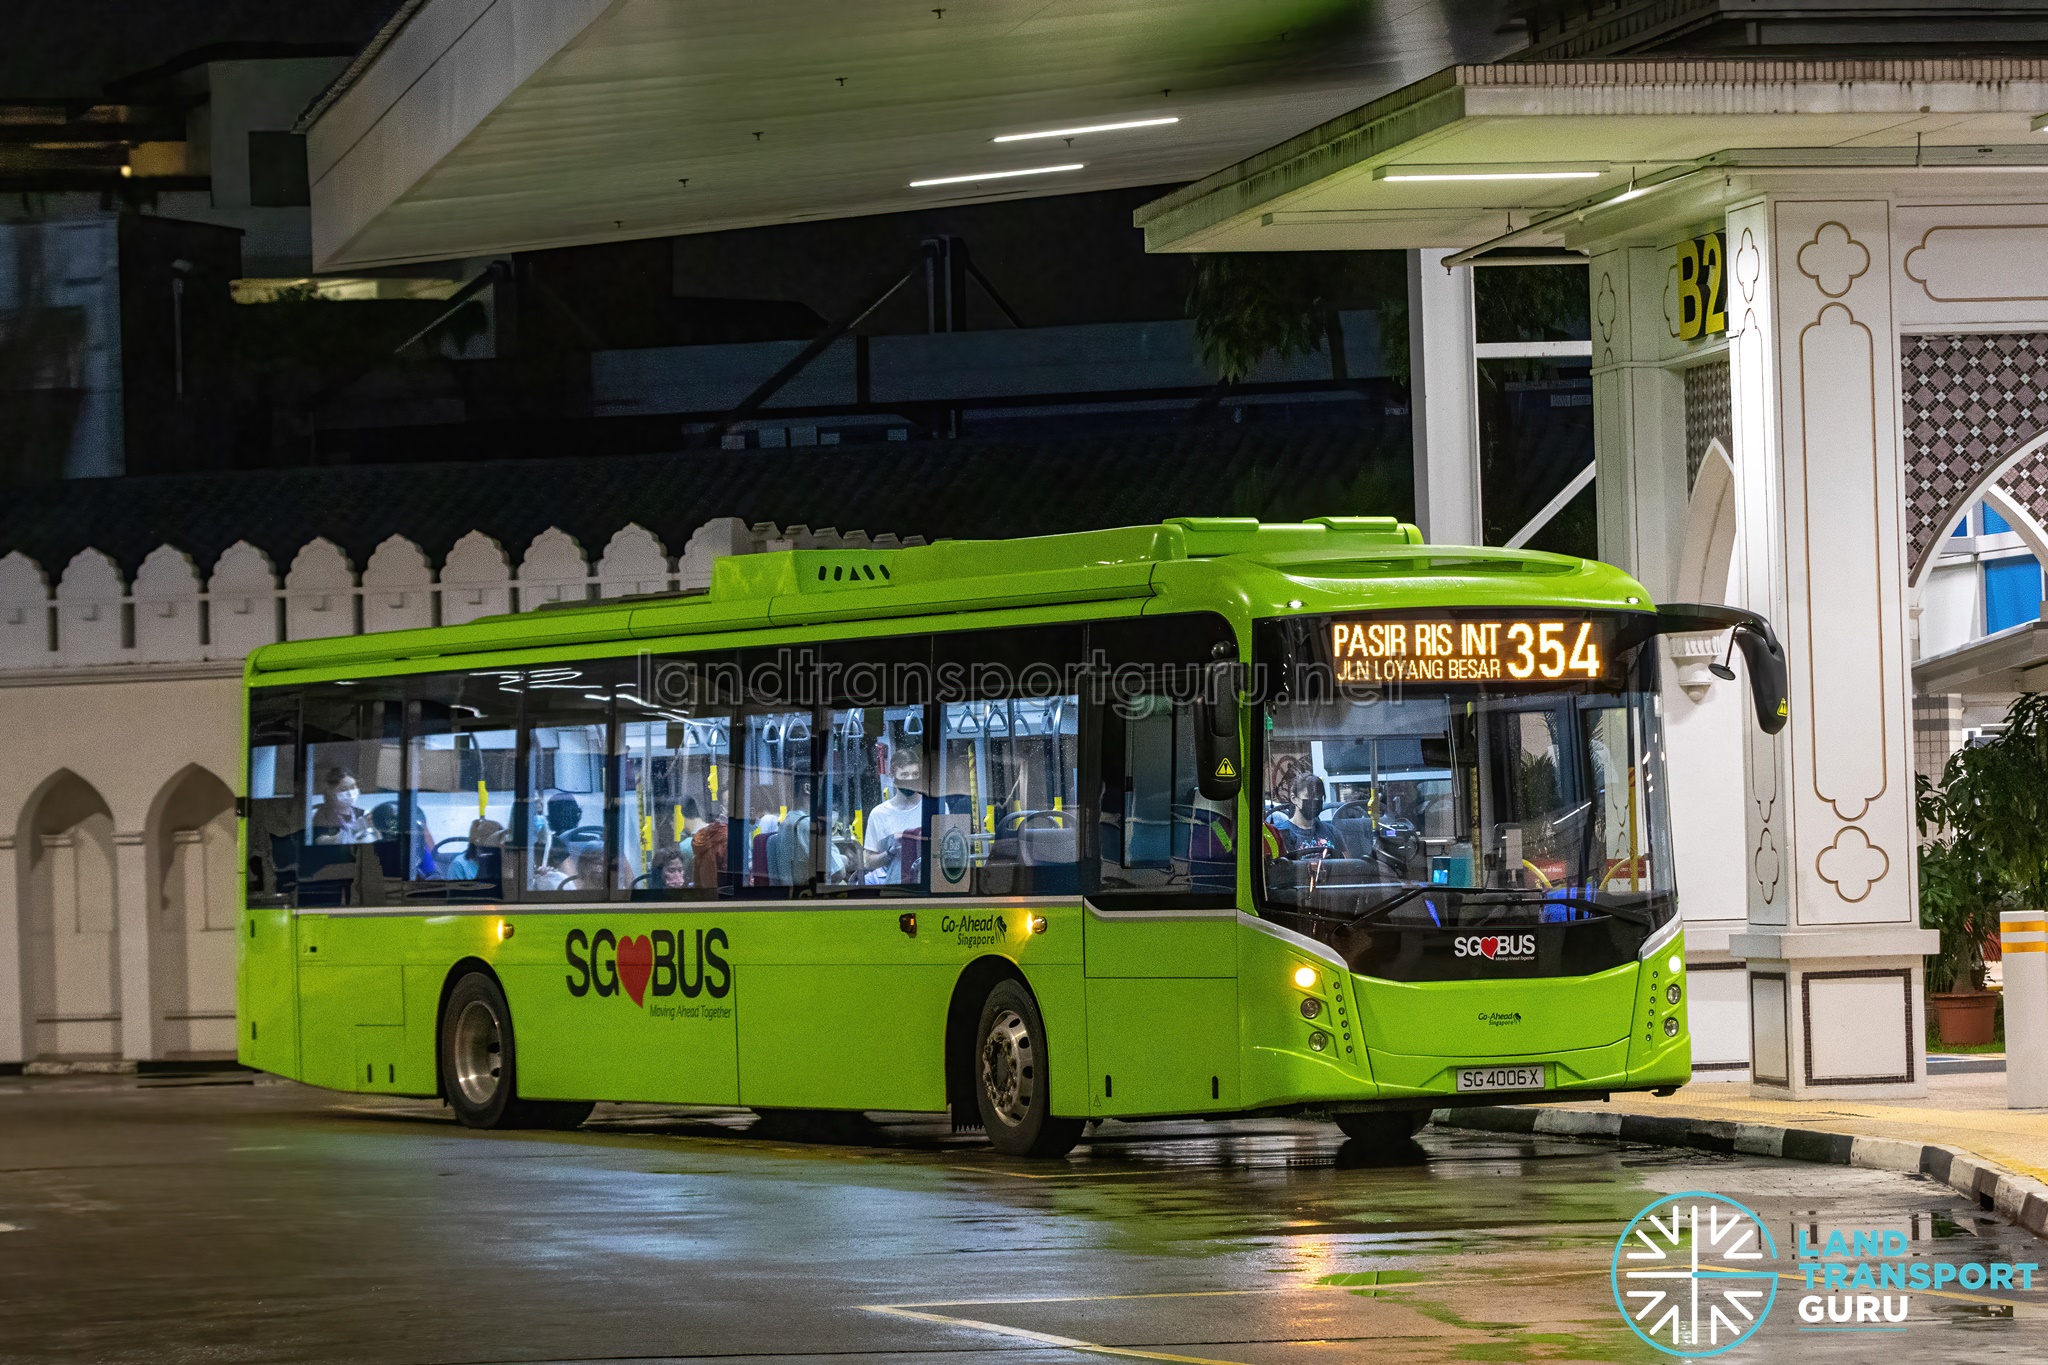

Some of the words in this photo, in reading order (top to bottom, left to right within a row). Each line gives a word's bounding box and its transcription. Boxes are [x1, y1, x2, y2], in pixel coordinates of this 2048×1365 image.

[1677, 233, 1725, 341] B2
[1334, 624, 1407, 657] PASIR
[1415, 624, 1453, 656] RIS
[1461, 623, 1502, 656] INT
[1507, 622, 1600, 679] 354
[1337, 659, 1370, 681] JLN
[1375, 658, 1444, 680] LOYANG
[1449, 657, 1502, 680] BESAR
[941, 914, 994, 933] Go-Ahead
[957, 933, 995, 948] Singapore
[650, 1005, 675, 1021] Moving
[676, 1004, 699, 1019] Ahead
[699, 1004, 732, 1021] Together
[1478, 1012, 1513, 1021] Go-Ahead
